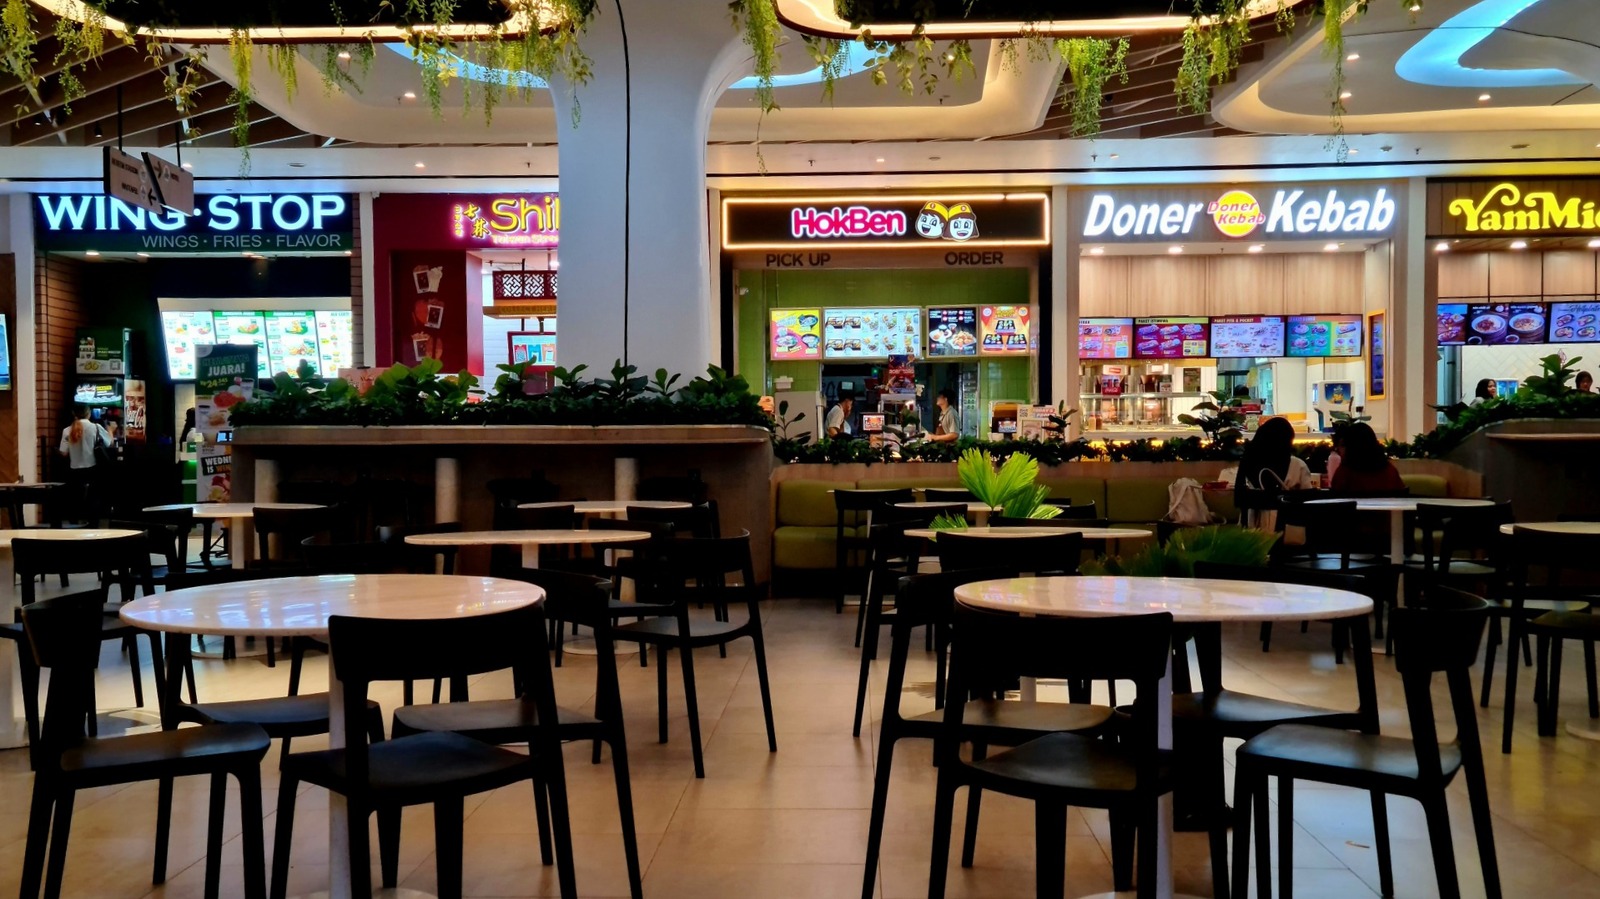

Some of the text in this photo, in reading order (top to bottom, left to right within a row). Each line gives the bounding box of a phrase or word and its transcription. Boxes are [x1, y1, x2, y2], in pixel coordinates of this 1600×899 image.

[208, 194, 345, 231] STOP
[1083, 188, 1397, 237] Doner Kebab
[1207, 200, 1257, 215] Doner
[792, 206, 907, 238] HokBen
[1218, 211, 1265, 226] Kebab
[142, 234, 341, 248] WINGS FRIES FLAVOR
[766, 252, 831, 267] PICK UP
[944, 251, 1004, 266] ORDER
[208, 363, 245, 376] JUARA!
